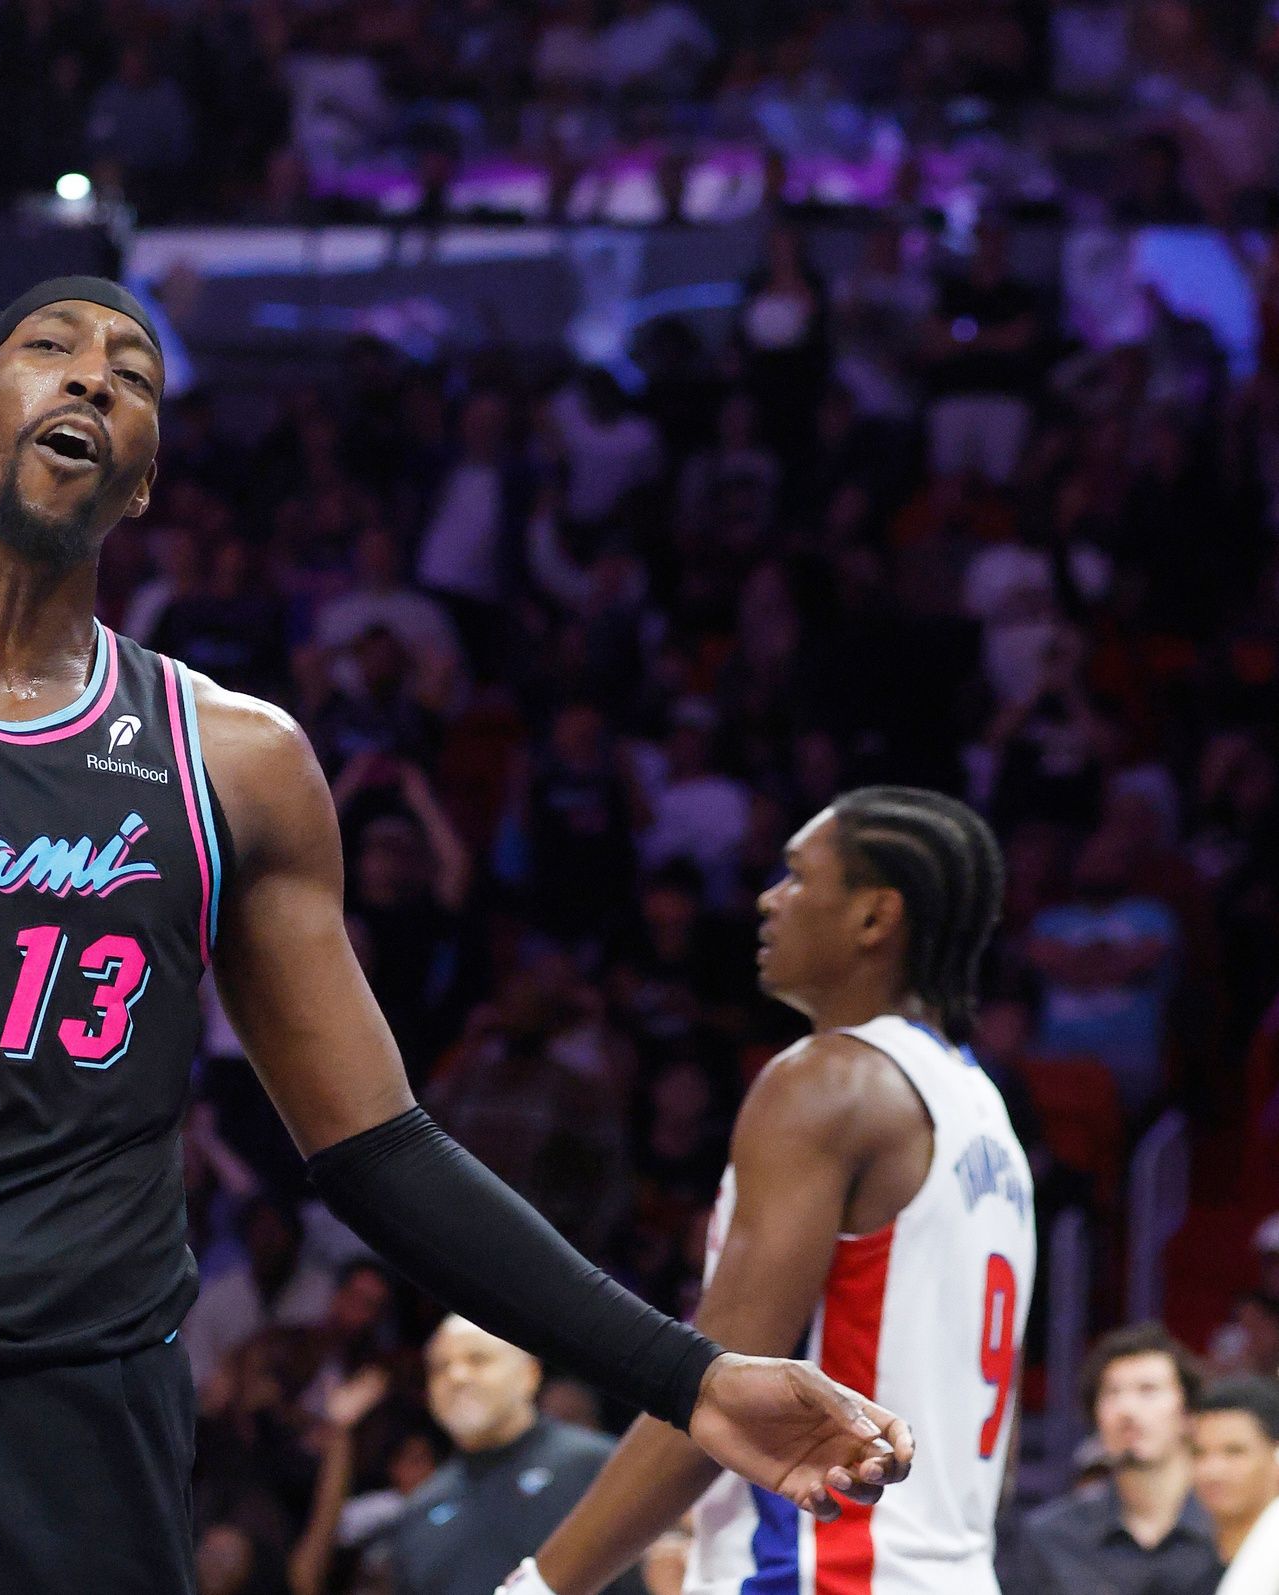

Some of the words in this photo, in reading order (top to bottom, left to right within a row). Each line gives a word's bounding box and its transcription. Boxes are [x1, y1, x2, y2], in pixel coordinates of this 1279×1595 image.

[86, 754, 168, 784] Robinhood
[0, 925, 151, 1070] 13
[979, 1252, 1016, 1460] 9
